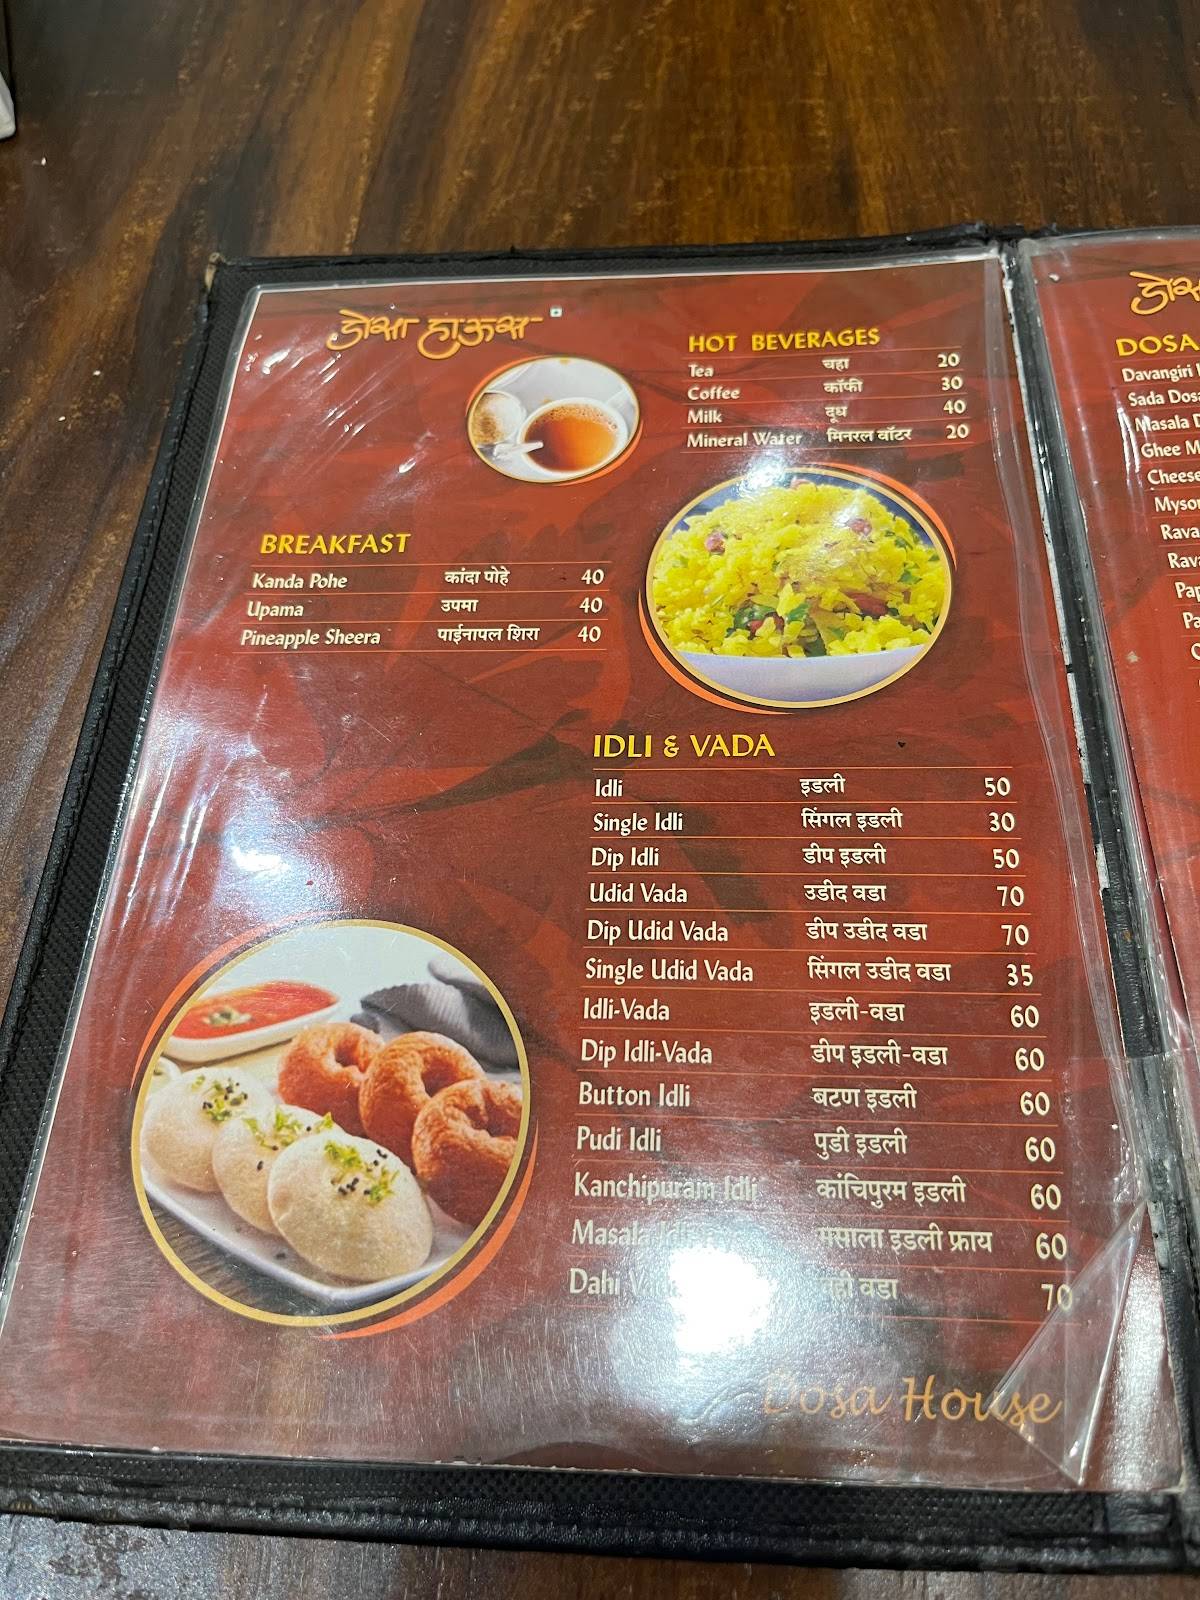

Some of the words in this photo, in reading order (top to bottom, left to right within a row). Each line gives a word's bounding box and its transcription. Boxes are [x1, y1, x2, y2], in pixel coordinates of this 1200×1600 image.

[688, 334, 738, 353] HOT
[751, 327, 880, 351] BEVERAGES
[688, 363, 715, 378] Tea
[822, 357, 850, 372] चहा
[937, 353, 961, 367] 20
[941, 375, 964, 391] 30
[1121, 363, 1194, 383] Davangiri
[687, 386, 741, 401] Coffee
[823, 378, 863, 394] कॉफी
[943, 400, 967, 415] 40
[1127, 390, 1166, 408] Sada
[687, 409, 723, 424] Milk
[825, 405, 848, 423] दूध
[687, 432, 748, 448] Mineral
[754, 432, 803, 446] Water
[827, 428, 874, 443] मिनरल
[877, 426, 912, 442] वॉटर
[946, 424, 970, 440] 20
[1140, 441, 1182, 459] Ghee
[260, 533, 411, 554] BREAKFAST
[1167, 552, 1200, 569] Rav
[252, 573, 304, 589] Kanda
[310, 573, 348, 589] Pohe
[444, 570, 481, 585] कांदा
[484, 566, 511, 585] पोहे
[580, 569, 605, 585] 40
[247, 602, 304, 619] Upama
[441, 599, 478, 613] उपमा
[579, 597, 603, 614] 40
[240, 630, 320, 650] Pineapple
[324, 629, 381, 646] Sheera
[437, 624, 502, 644] पाईनापल
[506, 625, 540, 642] शिरा
[577, 626, 602, 643] 40
[593, 734, 652, 758] IDLI
[663, 735, 680, 757] &
[690, 733, 777, 757] VADA
[595, 778, 624, 797] Idli
[800, 773, 846, 795] इडली
[984, 777, 1011, 797] 50
[593, 812, 648, 834] Single
[654, 812, 684, 832] Idli
[801, 808, 852, 829] सिंगल
[856, 806, 904, 831] इडली
[988, 812, 1016, 833] 30
[591, 847, 624, 871] Dip
[630, 847, 660, 867] Idli
[801, 841, 836, 864] डीप
[839, 843, 888, 867] इडली
[993, 848, 1020, 869] 50
[589, 882, 634, 903] Udid
[640, 882, 688, 903] Vada
[804, 880, 849, 903] उडीद
[851, 882, 888, 902] वडा
[997, 885, 1025, 907] 70
[587, 919, 622, 946] Dip
[627, 919, 675, 941] Udid
[679, 919, 729, 942] Vada
[805, 917, 840, 942] डीप
[843, 917, 889, 942] उडीद
[893, 920, 928, 942] वडा
[1001, 924, 1029, 947] 70
[584, 958, 645, 986] Single
[652, 958, 698, 981] Udid
[703, 960, 754, 982] Vada
[807, 954, 861, 982] सिंगल
[865, 955, 912, 982] उडीद
[916, 960, 952, 983] वडा
[1005, 964, 1034, 987] 35
[583, 997, 671, 1021] Idli-Vada
[809, 996, 906, 1024] इडली-वडा
[1010, 1004, 1040, 1029] 60
[580, 1038, 617, 1067] Dip
[623, 1038, 713, 1065] Idli-Vada
[811, 1037, 845, 1064] डीप
[850, 1040, 949, 1068] इडली-वडा
[1014, 1047, 1045, 1073] 60
[578, 1082, 652, 1107] Button
[657, 1082, 691, 1108] Idli
[810, 1086, 860, 1109] बटण
[864, 1082, 918, 1111] इडली
[1019, 1091, 1051, 1117] 60
[576, 1126, 622, 1152] Pudi
[629, 1126, 662, 1153] Idli
[814, 1125, 851, 1160] पुडी
[855, 1128, 908, 1157] इडली
[1024, 1136, 1056, 1163] 60
[574, 1171, 716, 1205] Kanchipuram
[816, 1173, 908, 1208] कांचिपुरम
[912, 1175, 967, 1206] इडली
[1030, 1184, 1062, 1212] 60
[888, 1222, 944, 1255] इडली
[947, 1229, 994, 1255] फ्राय
[1035, 1232, 1068, 1261] 60
[569, 1266, 622, 1296] Dahi
[858, 1278, 899, 1301] वडा
[1041, 1282, 1074, 1312] 70
